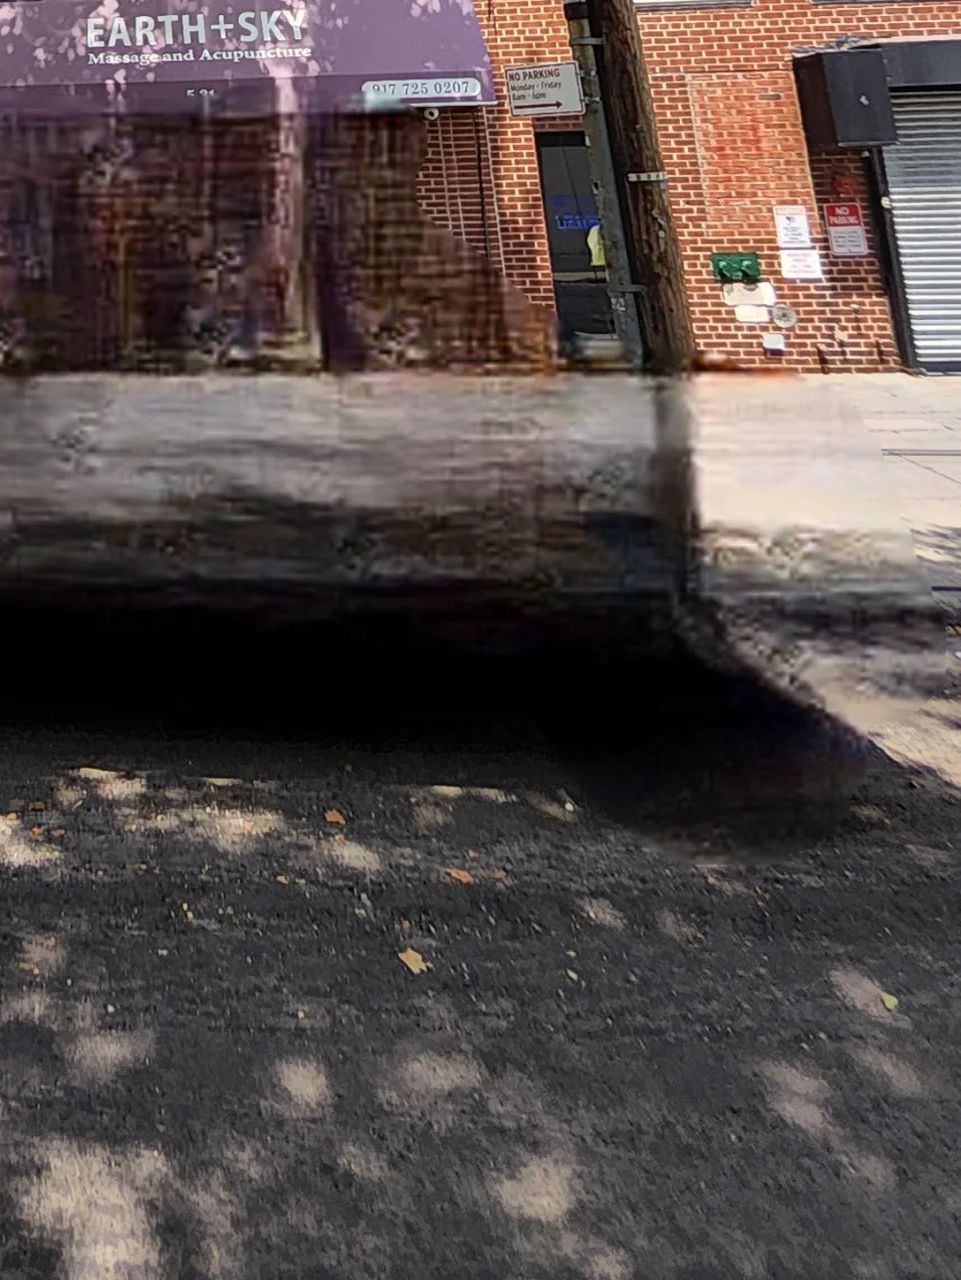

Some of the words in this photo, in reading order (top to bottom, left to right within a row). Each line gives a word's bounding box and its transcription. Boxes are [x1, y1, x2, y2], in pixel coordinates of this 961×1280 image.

[87, 10, 307, 48] EARTH+SKY
[88, 52, 160, 66] Massage
[162, 49, 195, 62] and
[200, 47, 312, 63] Acupuncture
[508, 72, 521, 81] NO
[523, 68, 560, 80] PARKING
[402, 82, 429, 95] 725
[433, 80, 469, 94] 0207
[835, 206, 850, 216] NO
